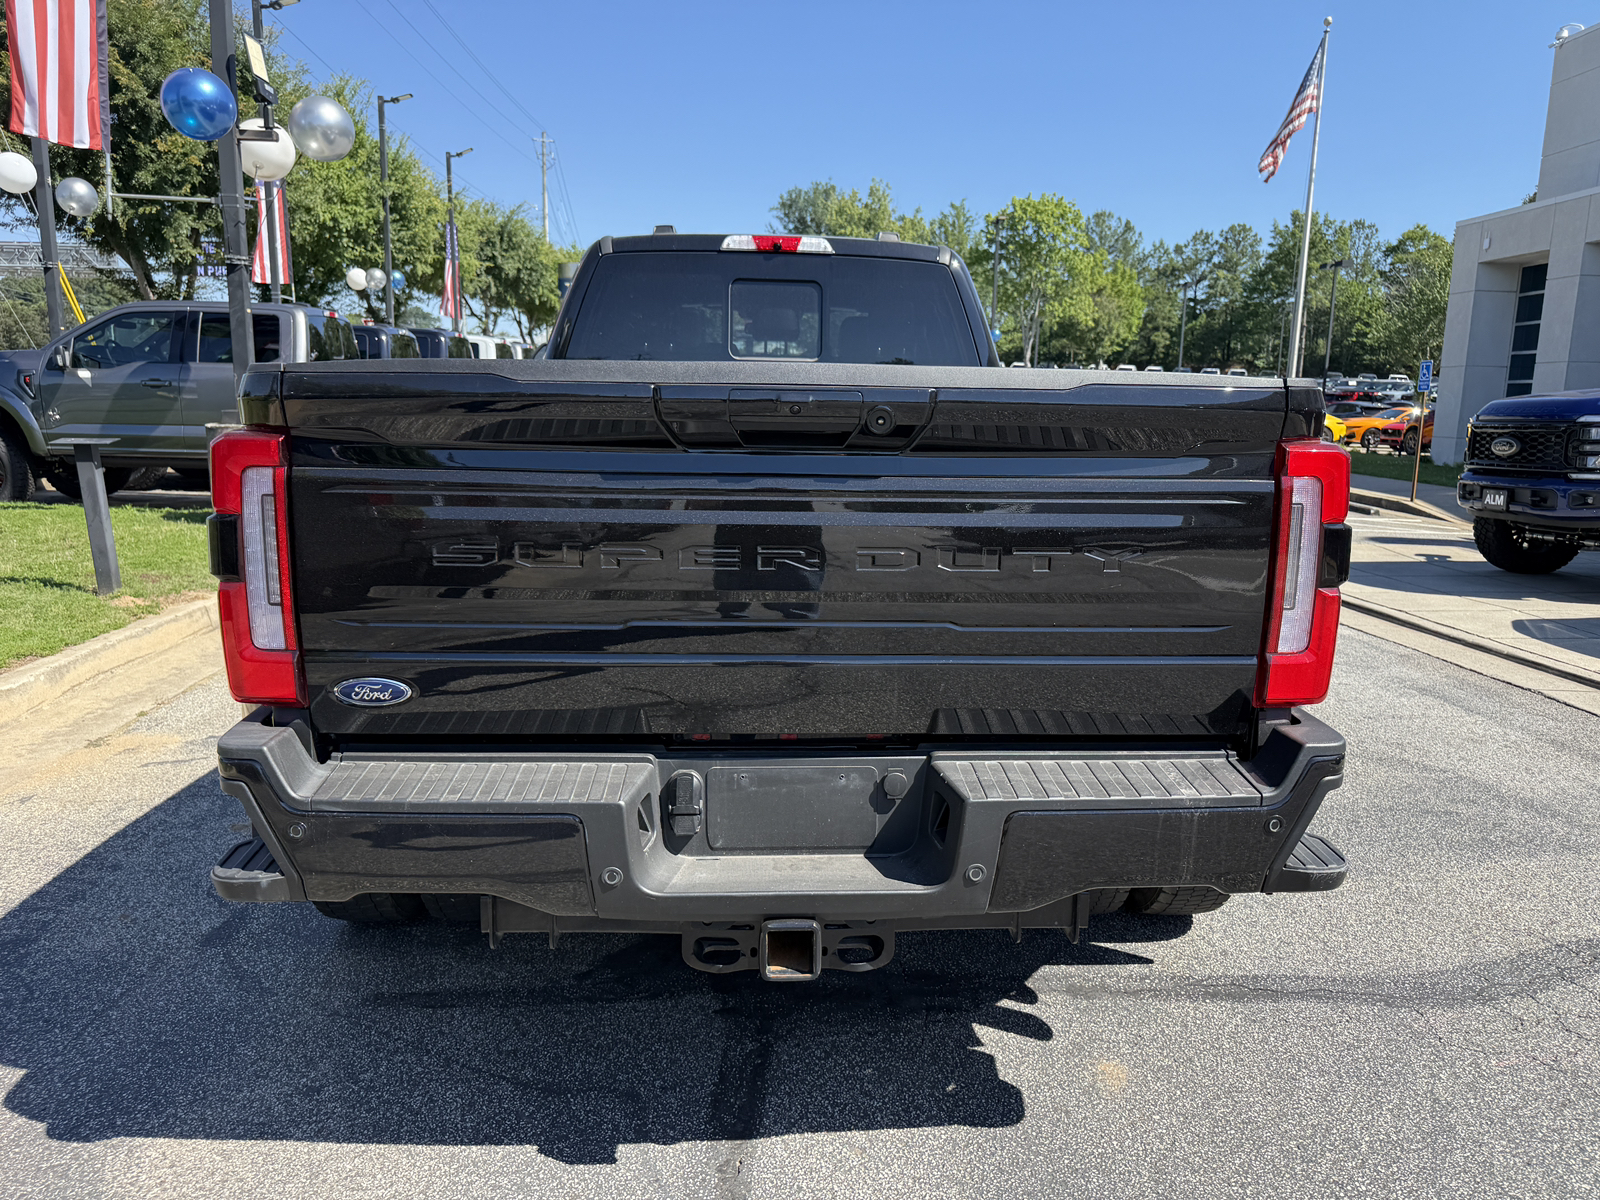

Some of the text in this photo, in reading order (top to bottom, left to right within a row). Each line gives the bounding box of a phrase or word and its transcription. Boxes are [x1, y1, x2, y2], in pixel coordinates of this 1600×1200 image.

[1484, 493, 1505, 506] ALM
[432, 541, 1144, 573] SUPER DUTY
[351, 683, 393, 701] Ford
